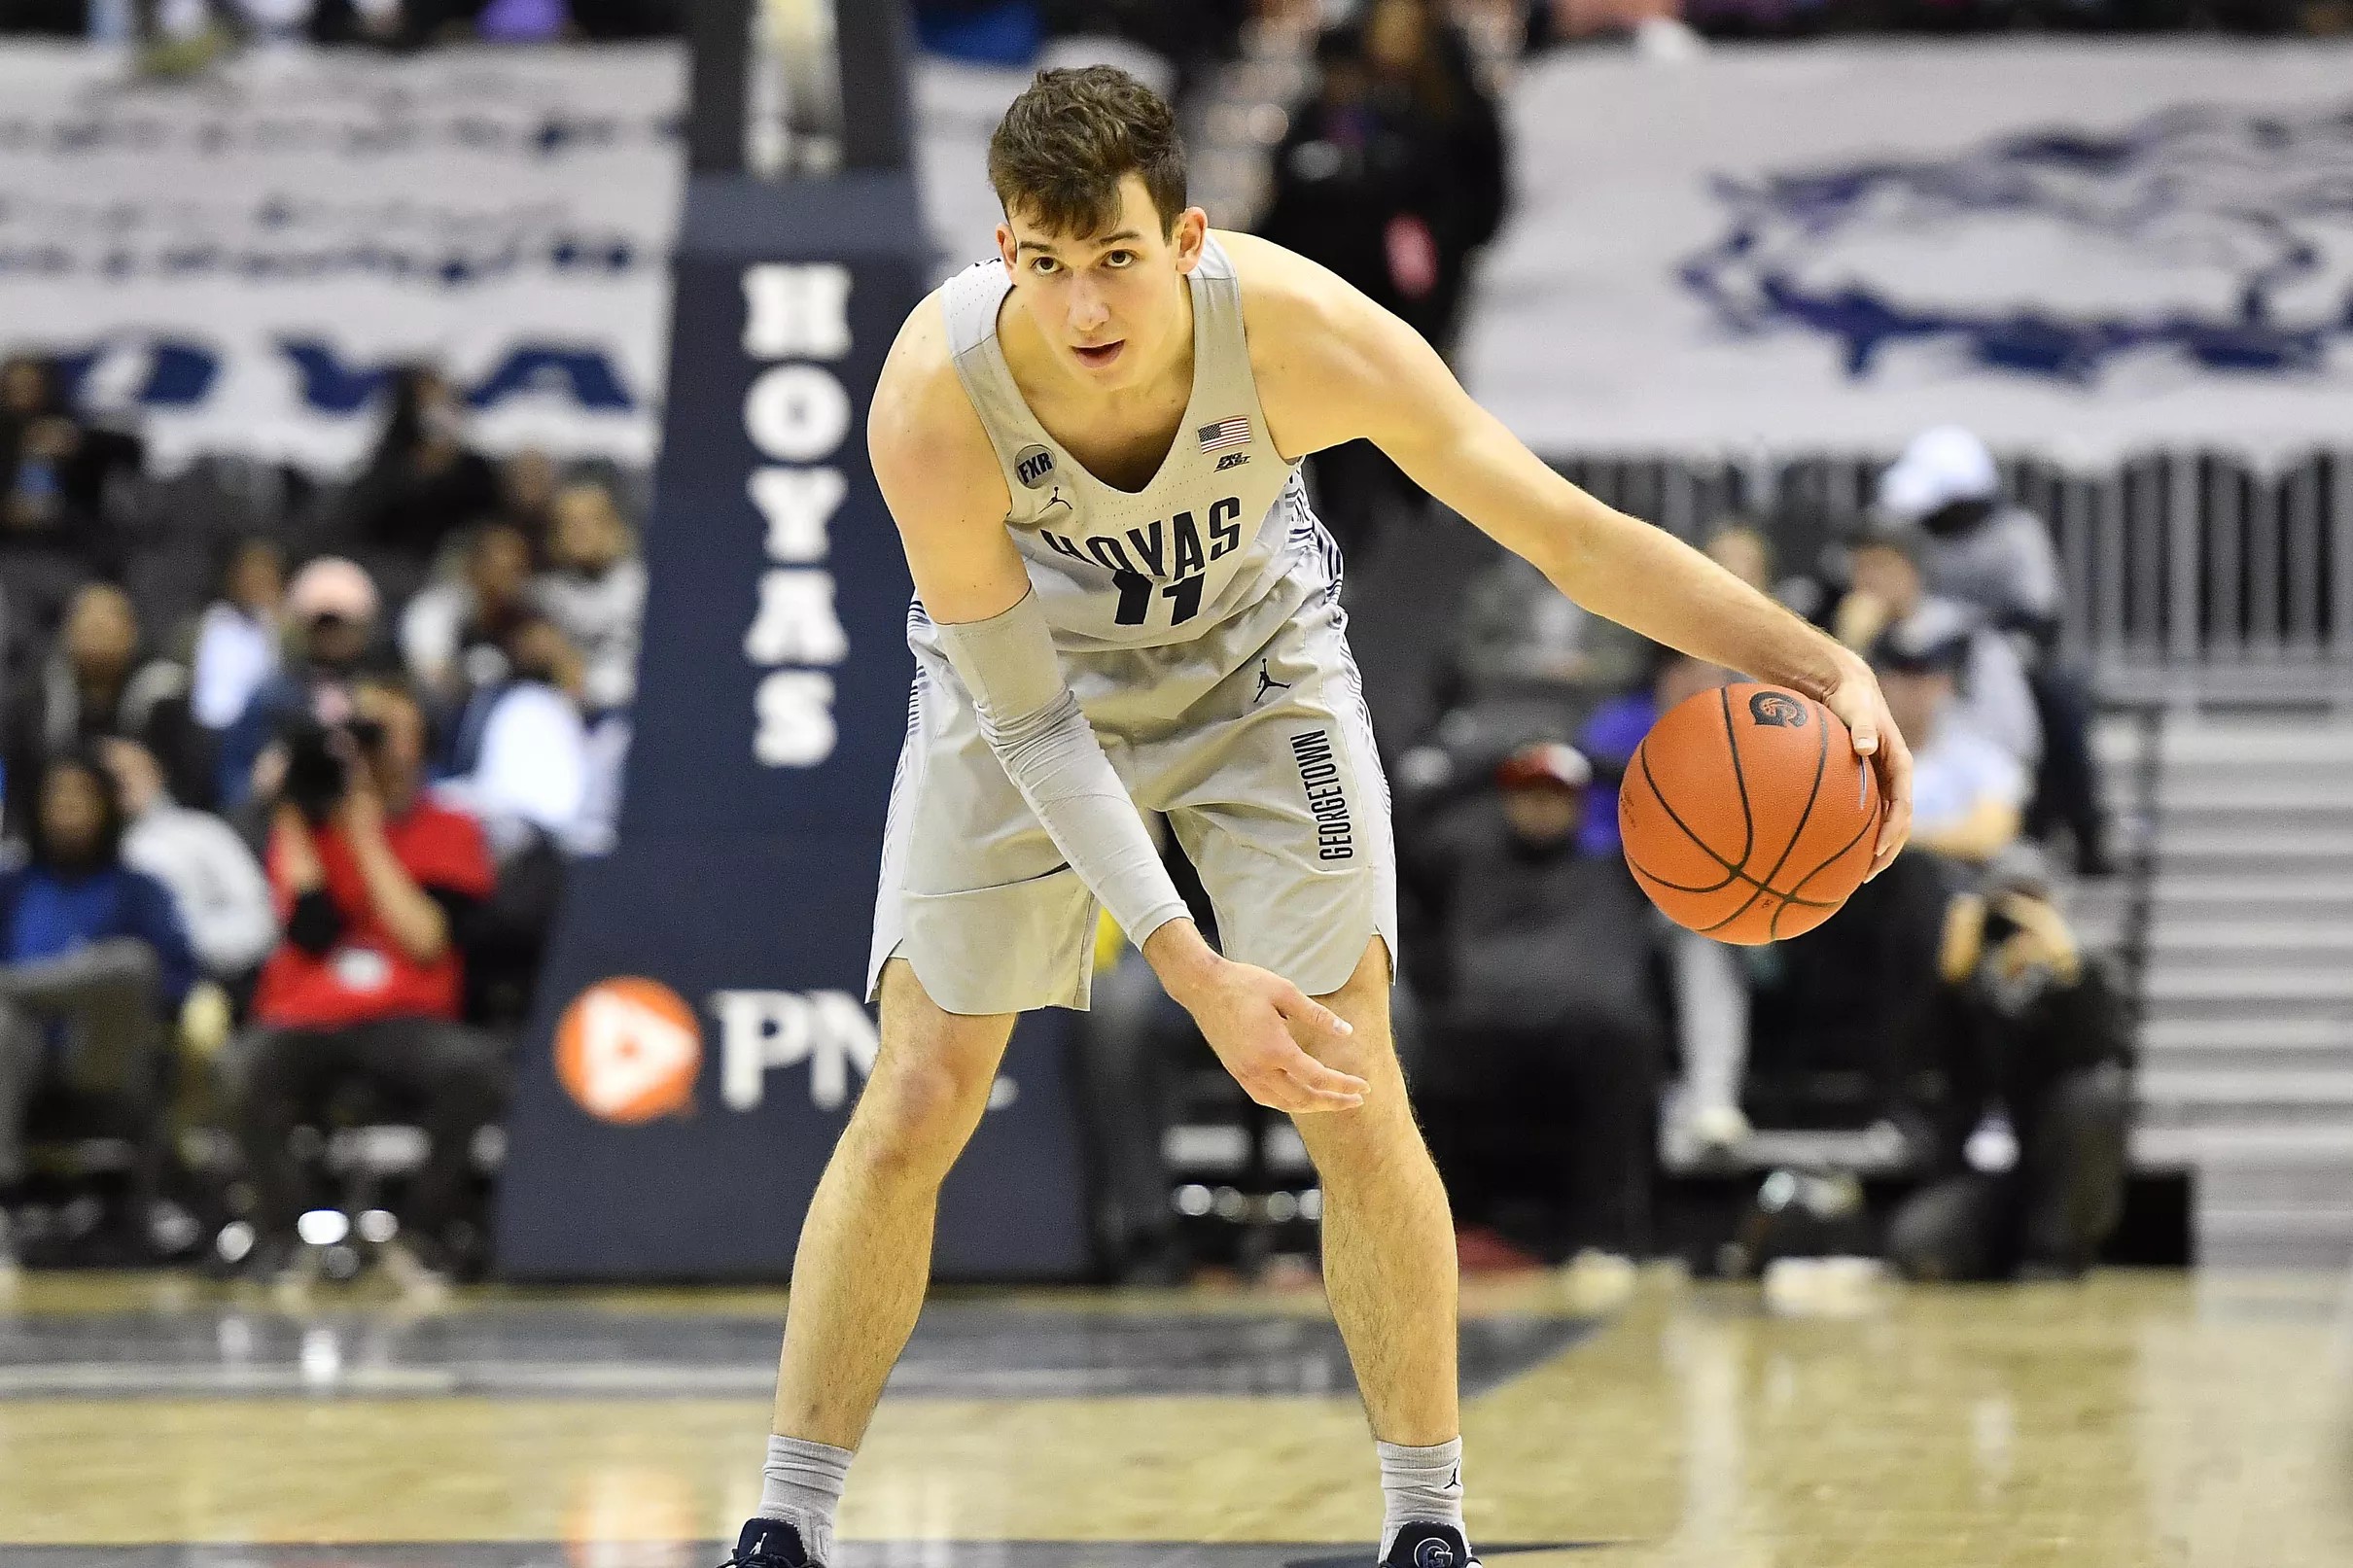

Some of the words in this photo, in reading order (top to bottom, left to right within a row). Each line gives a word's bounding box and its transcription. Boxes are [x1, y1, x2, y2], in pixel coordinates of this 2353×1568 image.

[742, 263, 854, 767] HOYAS
[1018, 452, 1053, 484] FXR
[1111, 569, 1206, 627] 11
[1290, 729, 1353, 860] GEORGETOWN
